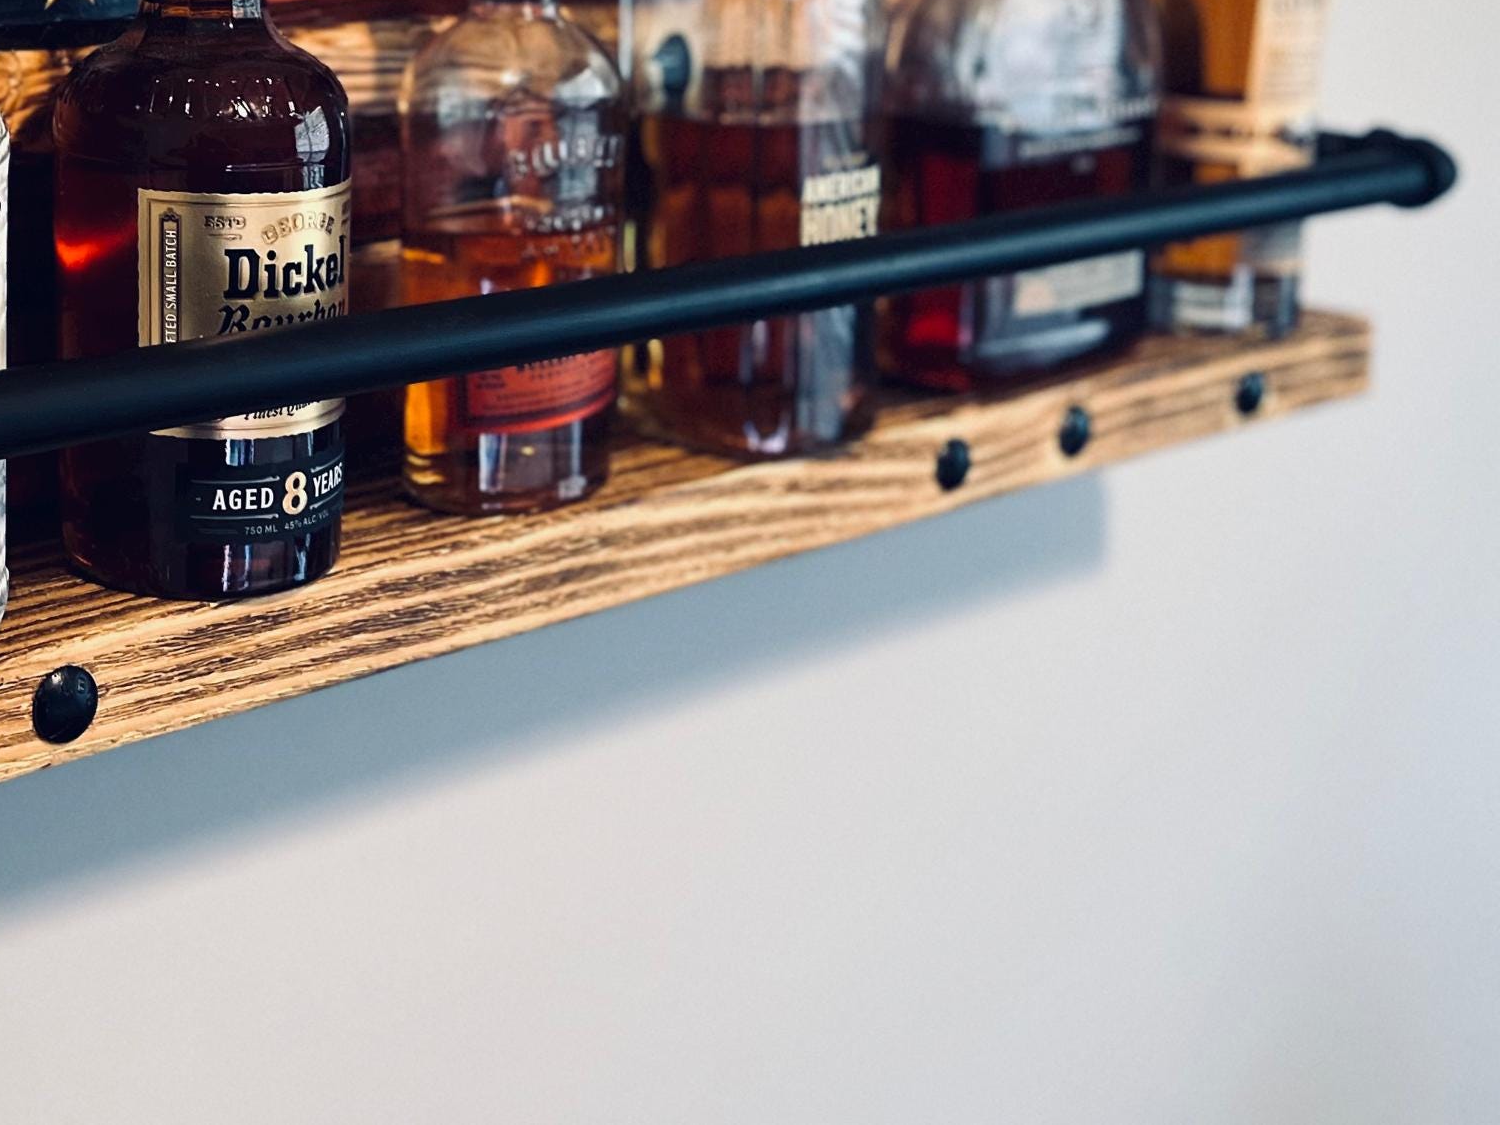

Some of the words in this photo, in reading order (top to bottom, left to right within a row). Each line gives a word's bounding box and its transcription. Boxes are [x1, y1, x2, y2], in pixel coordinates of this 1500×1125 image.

[260, 210, 336, 246] GEORGE
[165, 229, 178, 268] BATCH
[223, 234, 347, 300] Dickel
[165, 270, 177, 310] SMALL
[212, 487, 275, 511] AGED
[282, 471, 308, 515] 8
[312, 461, 344, 498] YEARS
[244, 526, 263, 536] 750
[264, 525, 279, 535] ML
